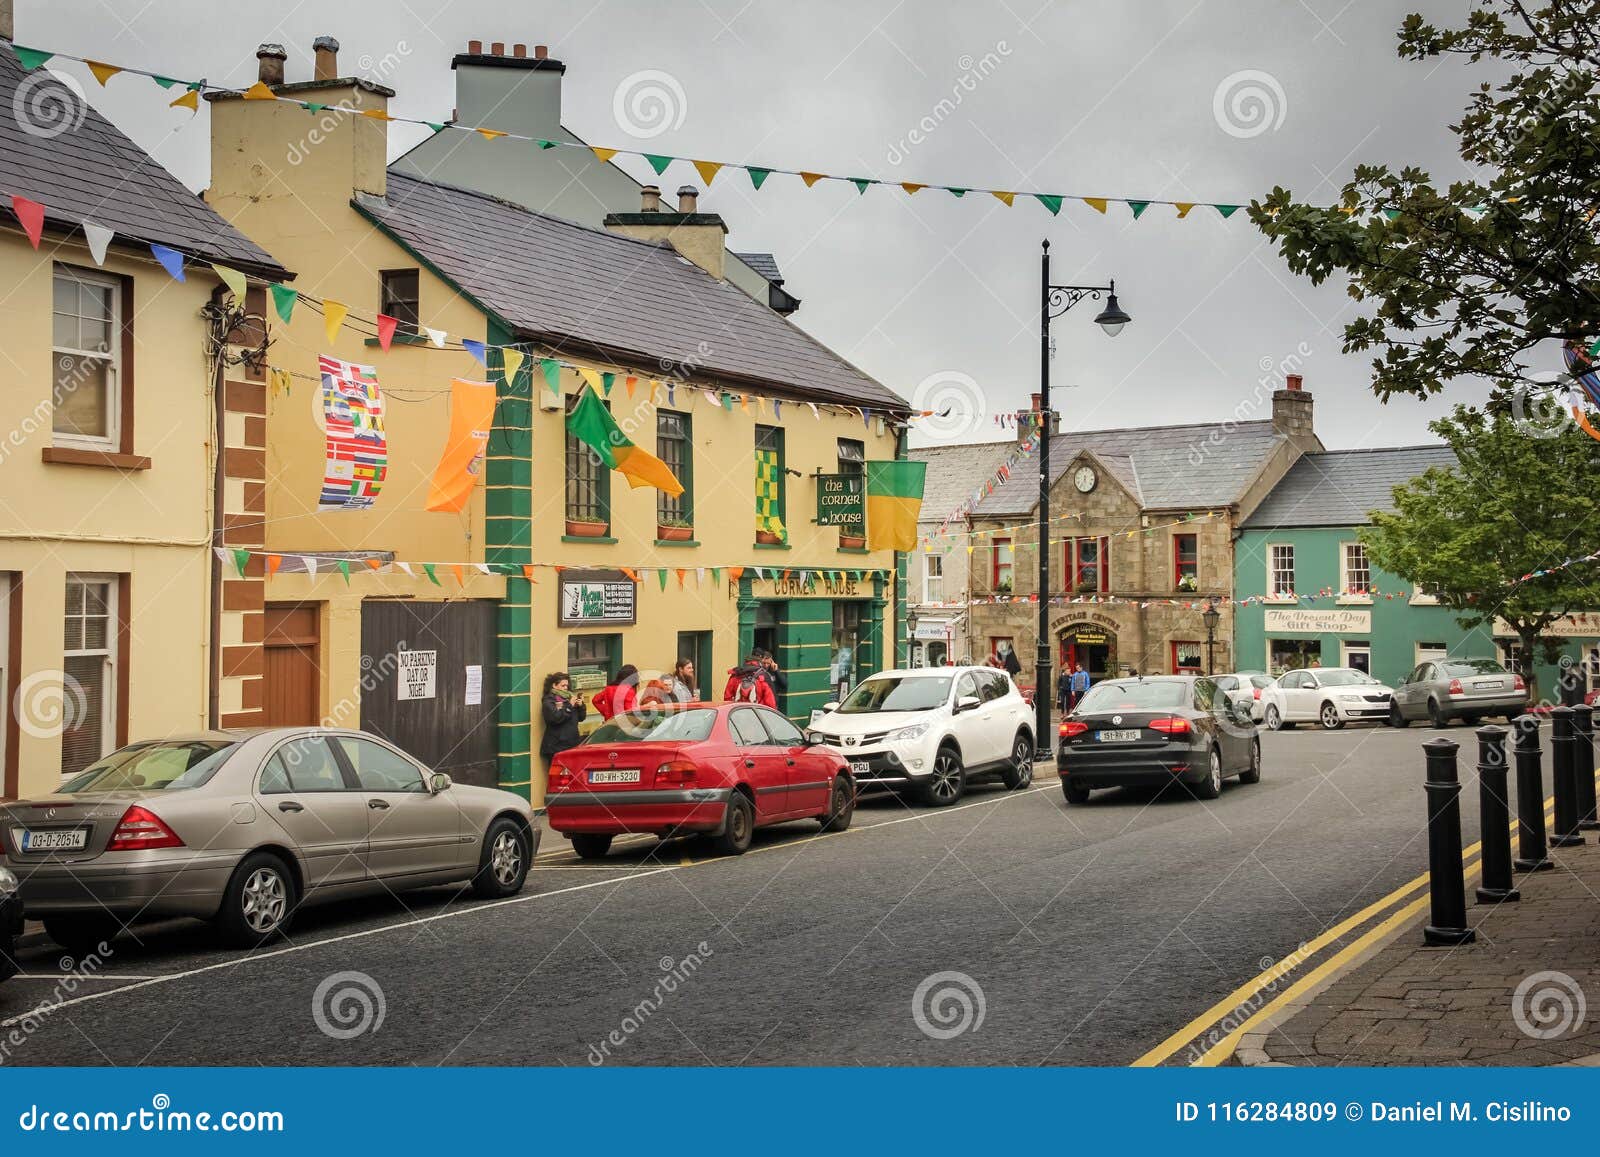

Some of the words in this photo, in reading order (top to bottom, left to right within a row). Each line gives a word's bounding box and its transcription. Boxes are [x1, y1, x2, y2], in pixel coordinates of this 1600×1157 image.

[825, 480, 843, 492] the
[830, 510, 862, 523] house
[1269, 611, 1292, 621] The
[1340, 611, 1366, 624] Day
[400, 653, 409, 667] NO
[410, 652, 435, 667] PARKING
[407, 668, 419, 683] DAY
[420, 667, 429, 682] OR
[408, 683, 426, 698] NIGHT
[853, 763, 869, 772] PGU
[595, 771, 638, 781] 00-WH-5230
[32, 834, 80, 848] 03-D-20514
